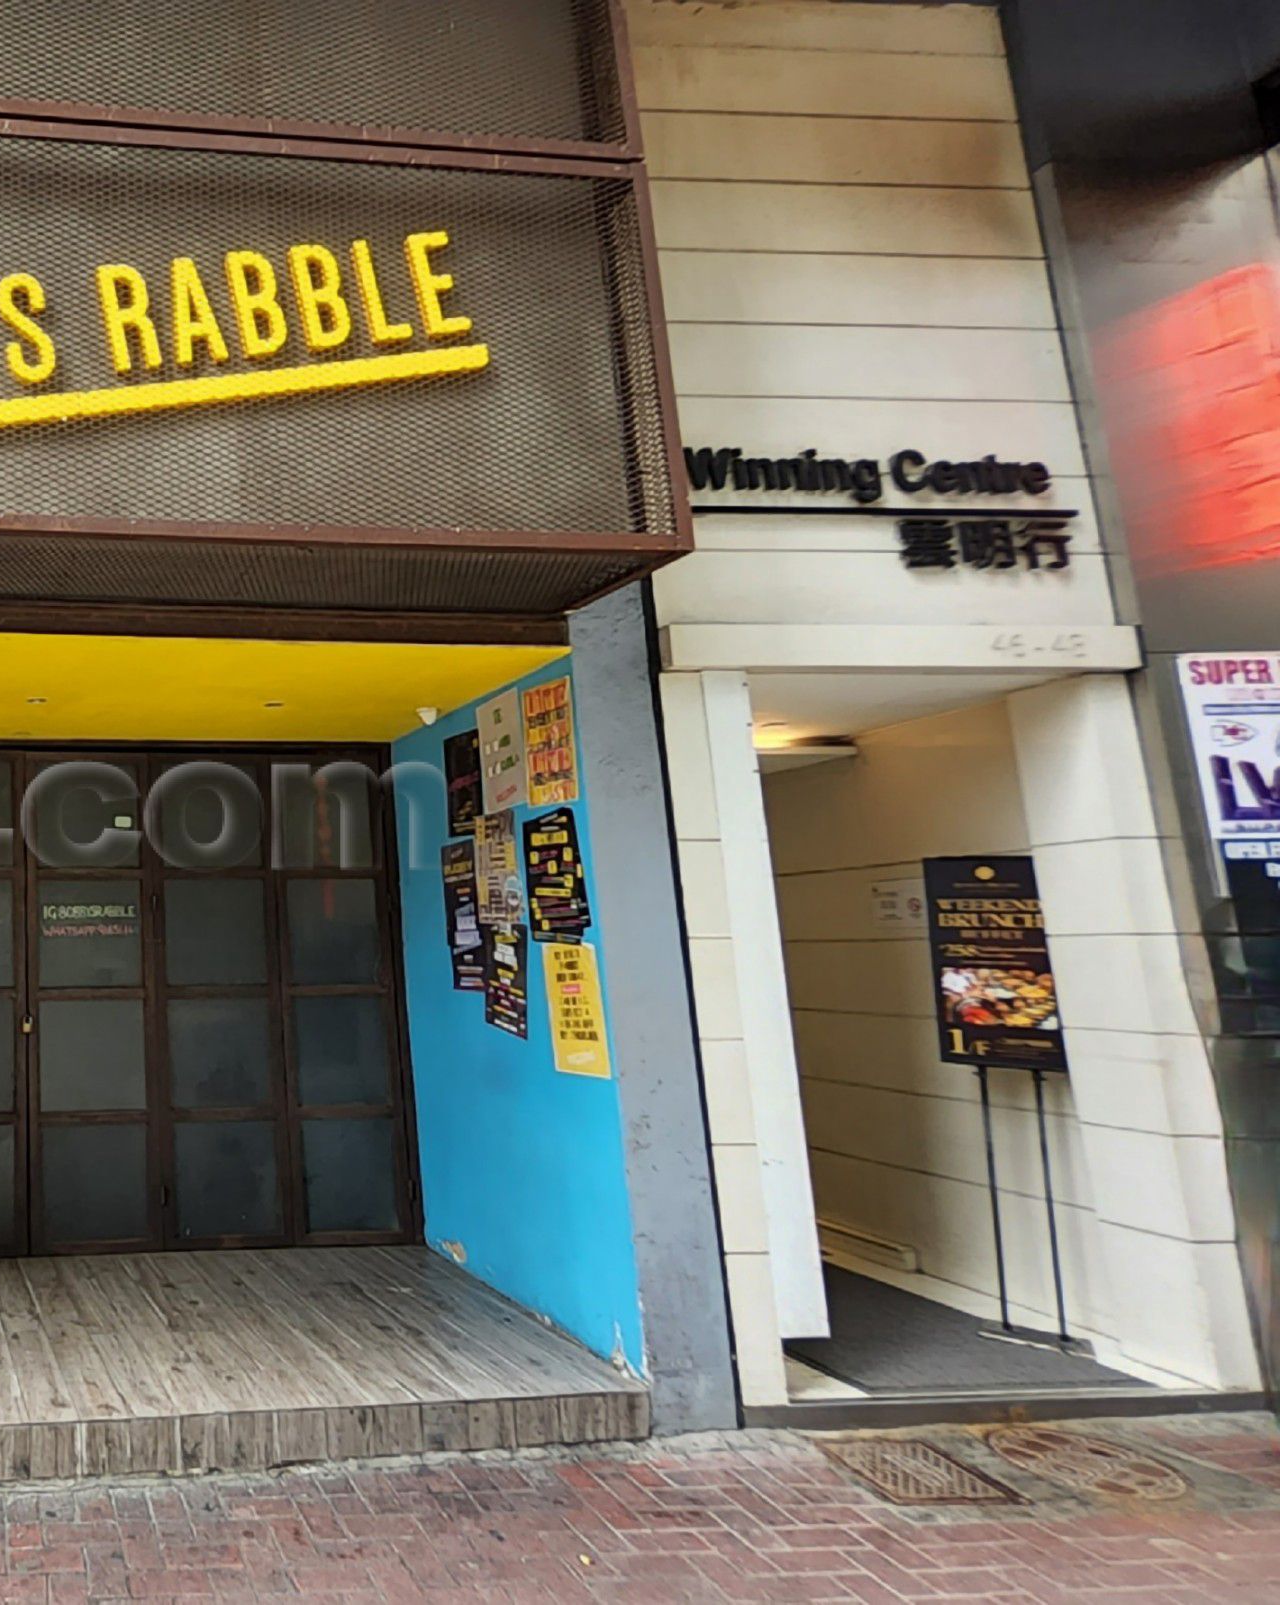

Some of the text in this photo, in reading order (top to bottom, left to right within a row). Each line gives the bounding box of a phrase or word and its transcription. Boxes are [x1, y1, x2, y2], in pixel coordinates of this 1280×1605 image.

[94, 230, 473, 373] RABBLE
[682, 447, 1051, 503] Winning Centre
[1188, 660, 1275, 685] SUPER
